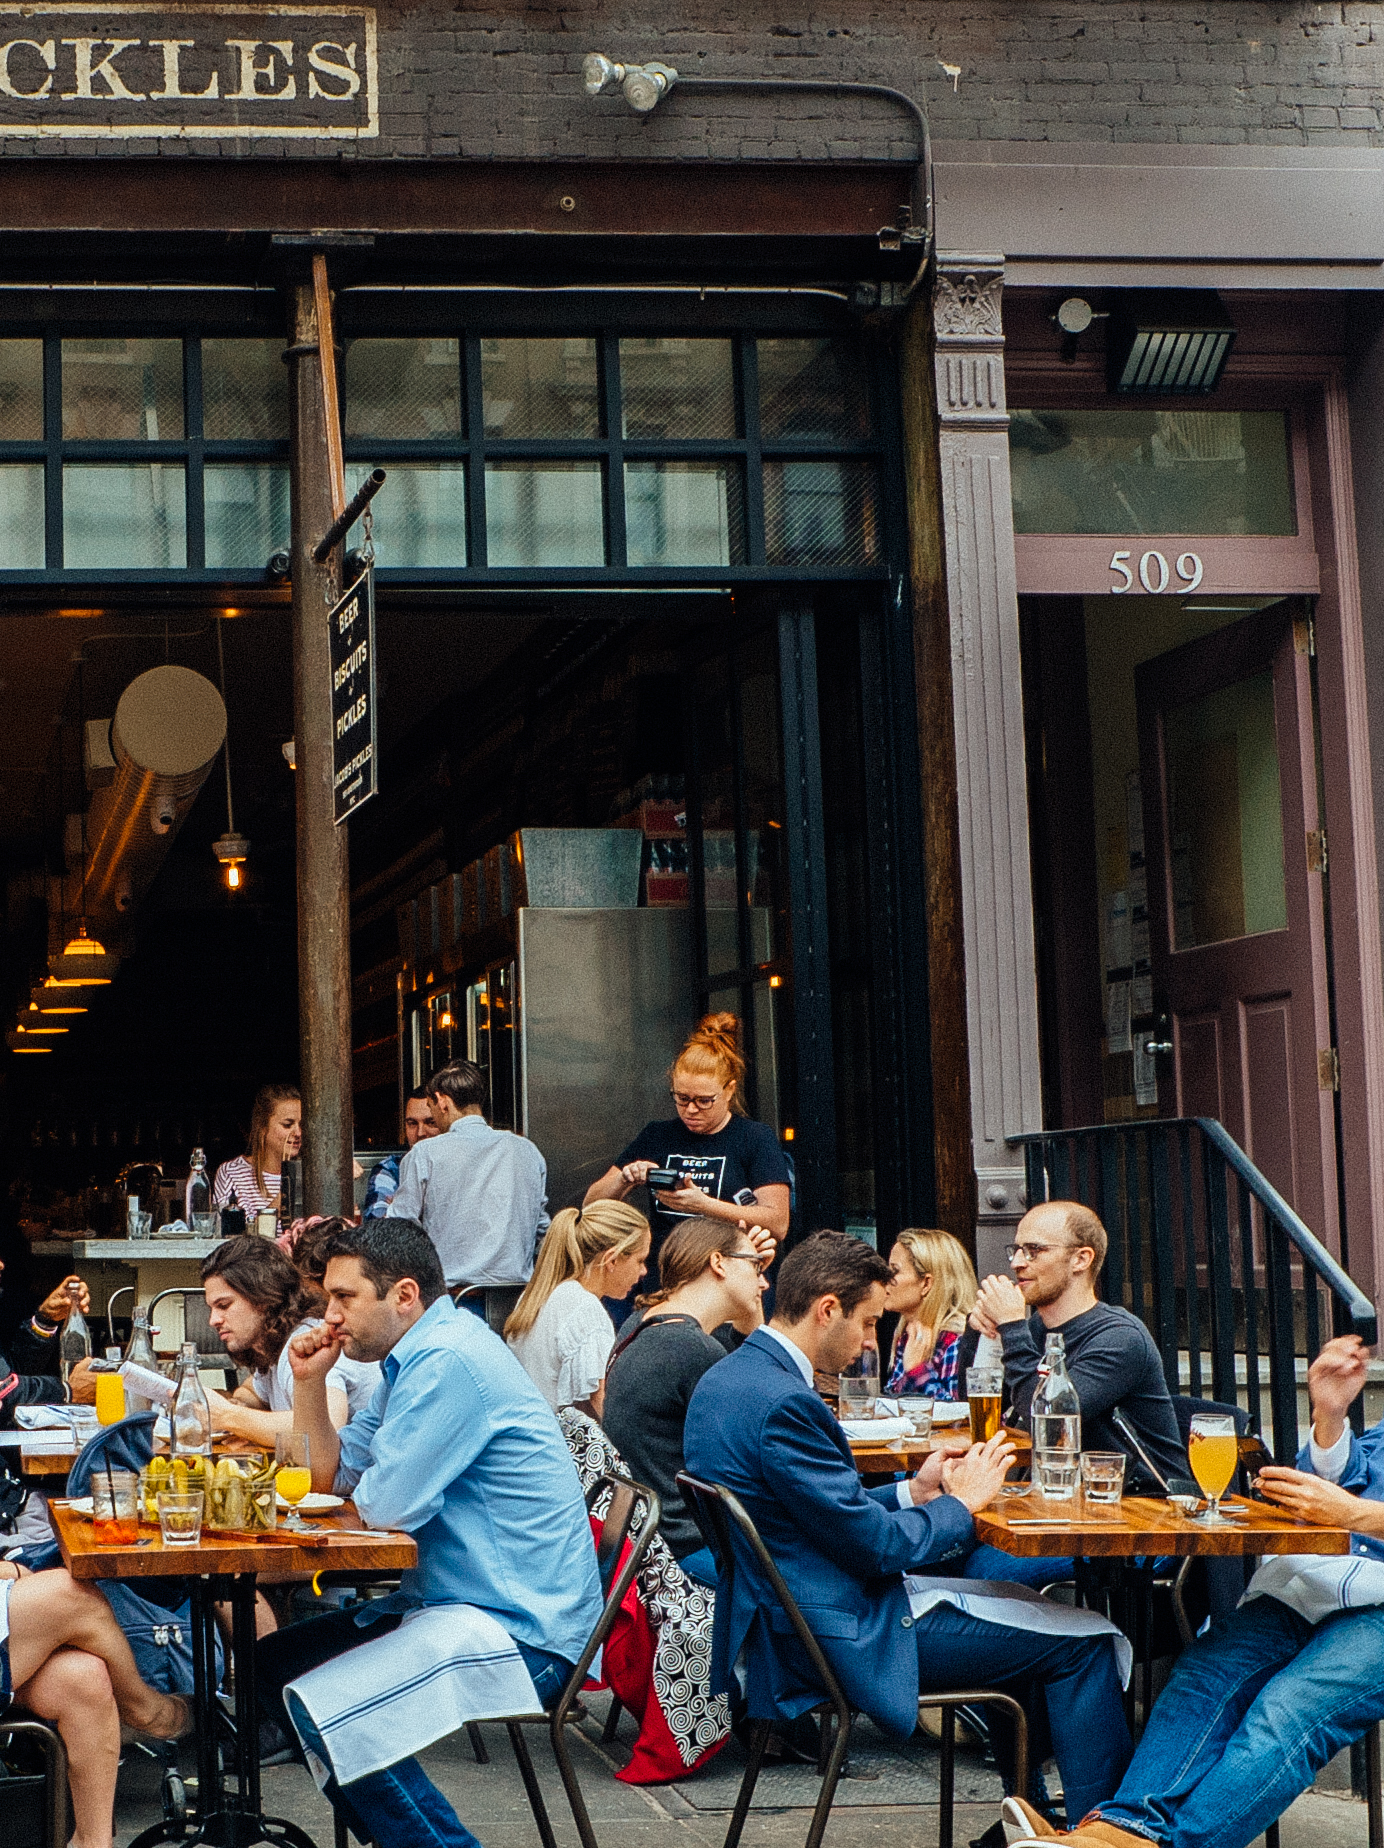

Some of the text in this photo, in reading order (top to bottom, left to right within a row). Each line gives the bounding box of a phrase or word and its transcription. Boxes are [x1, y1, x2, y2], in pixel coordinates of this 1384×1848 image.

[1109, 551, 1204, 594] 509
[339, 597, 359, 635] BEER
[334, 640, 368, 692] BISCUITS
[336, 694, 367, 740] PICKLES
[682, 1159, 709, 1167] BEER
